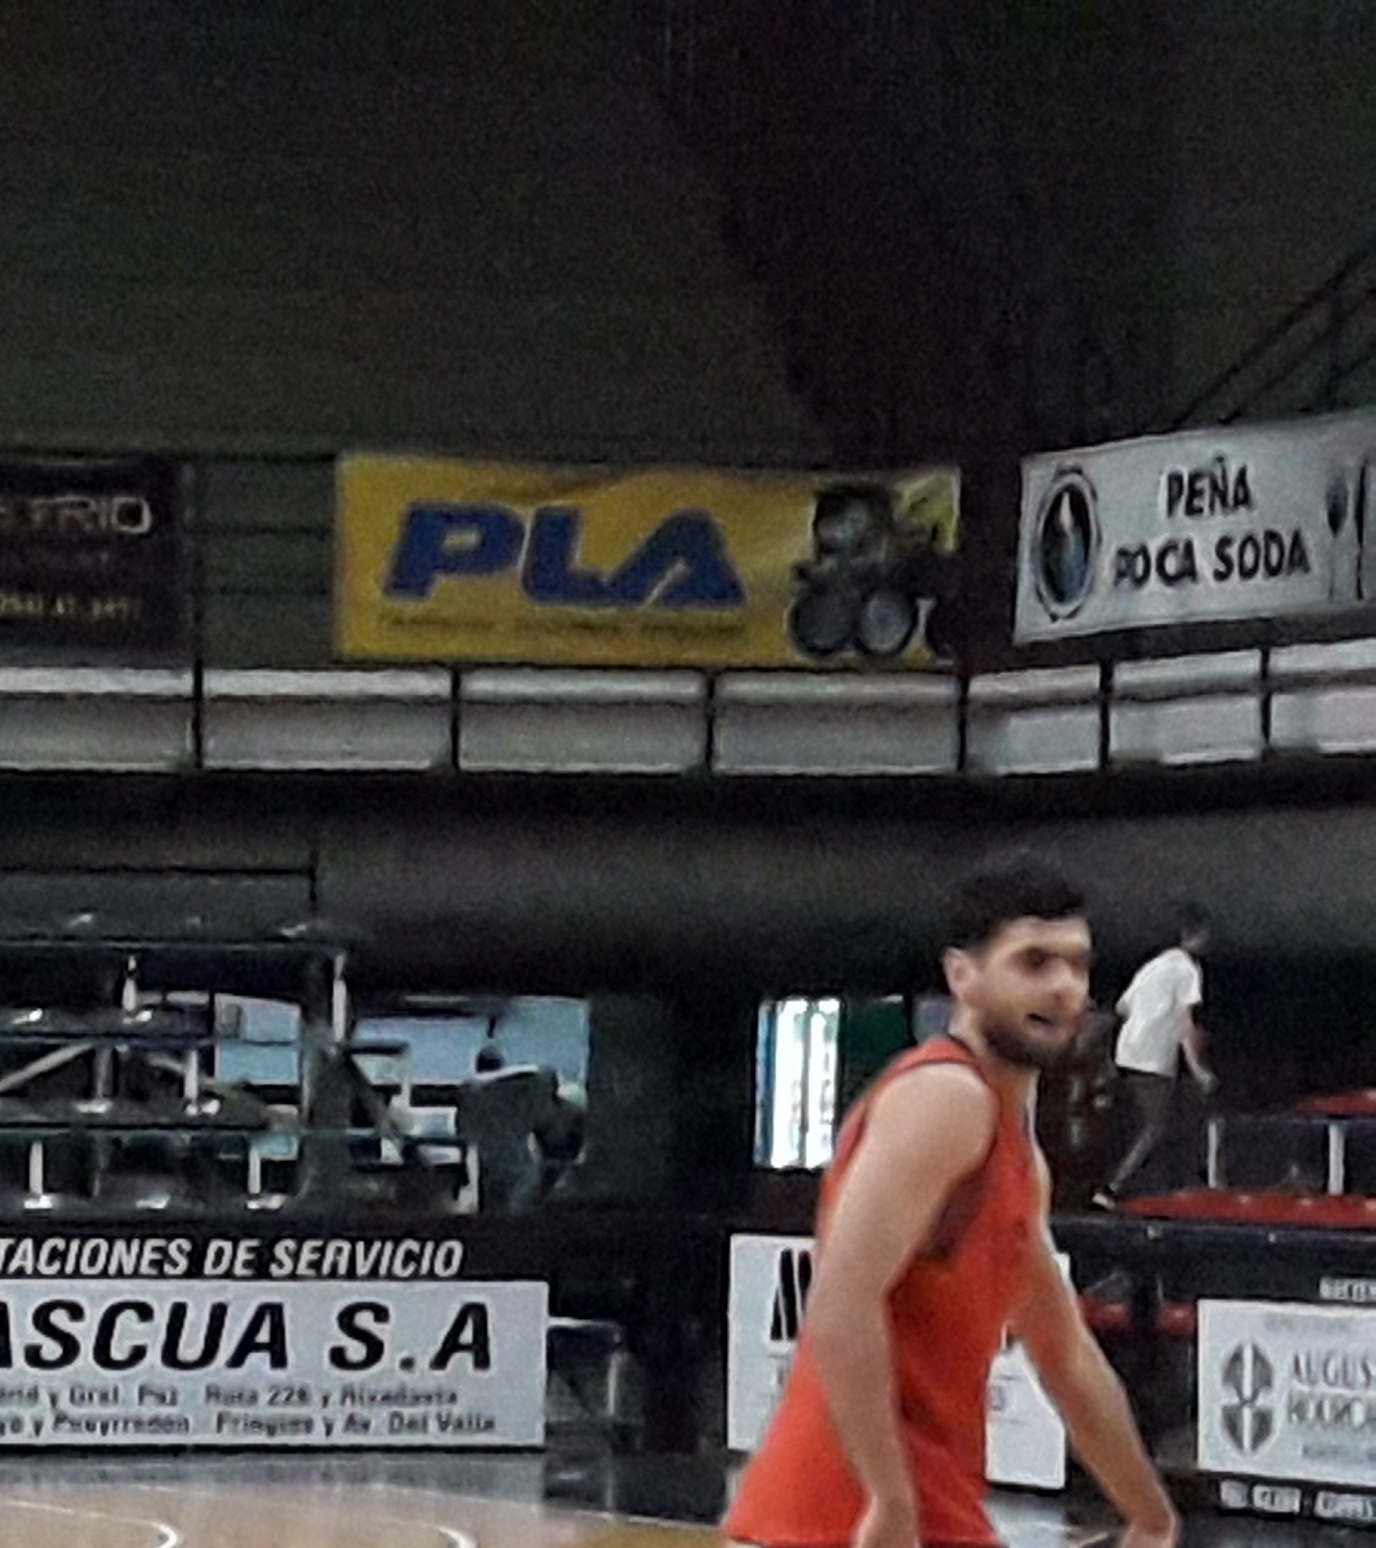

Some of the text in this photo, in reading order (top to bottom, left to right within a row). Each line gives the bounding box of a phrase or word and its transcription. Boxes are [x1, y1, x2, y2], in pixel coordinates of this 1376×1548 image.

[382, 502, 748, 608] PLA
[1213, 528, 1311, 582] SODA
[204, 1239, 253, 1276] DE
[269, 1239, 464, 1278] SERVICIO
